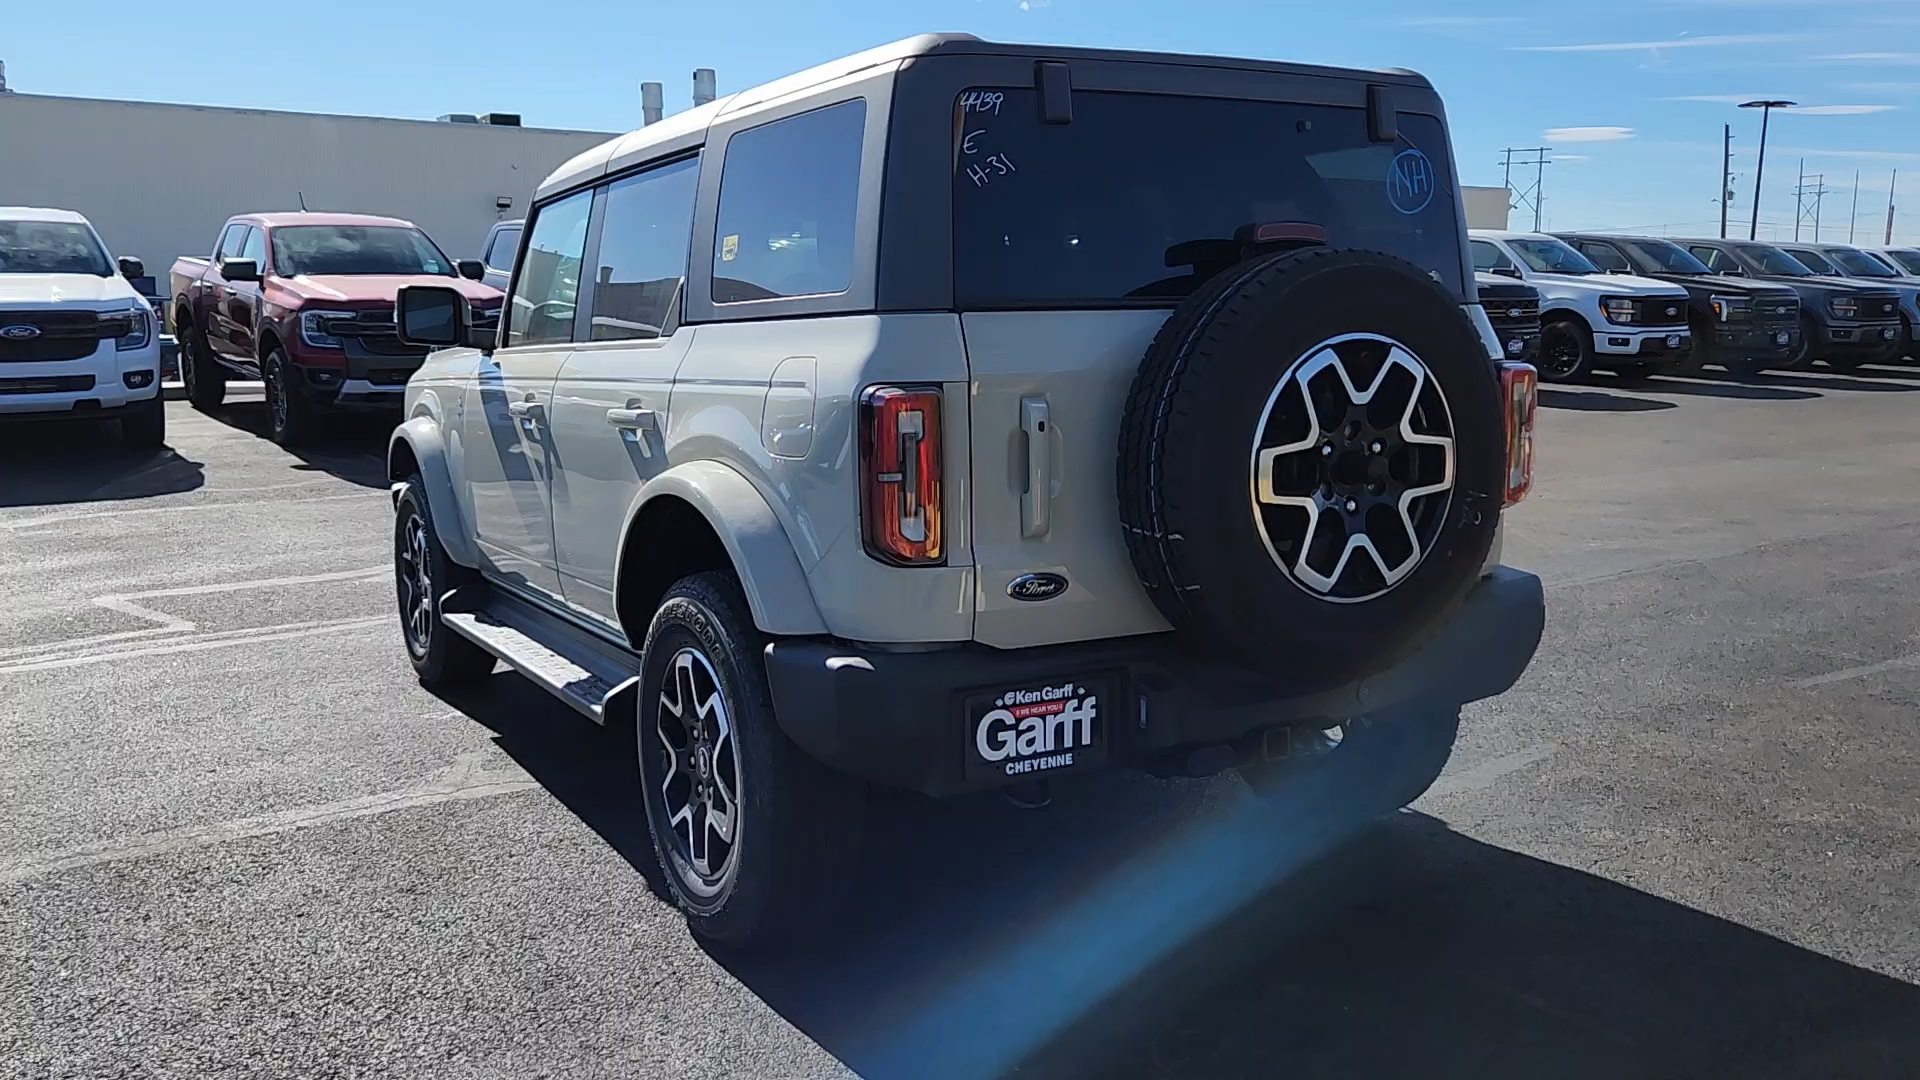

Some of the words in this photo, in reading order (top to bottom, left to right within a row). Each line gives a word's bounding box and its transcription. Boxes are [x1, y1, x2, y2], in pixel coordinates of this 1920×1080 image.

[960, 91, 1004, 116] 4439
[963, 129, 987, 154] E
[966, 152, 1016, 188] H-31
[1395, 159, 1428, 198] NH
[1022, 579, 1056, 595] Ford
[1016, 690, 1041, 705] Ken
[1042, 683, 1074, 701] Garff
[1020, 707, 1030, 715] WE
[1030, 705, 1047, 714] HEAR
[1047, 703, 1059, 712] YOU
[976, 696, 1096, 761] Garff
[1005, 752, 1074, 776] CHEYENNE
